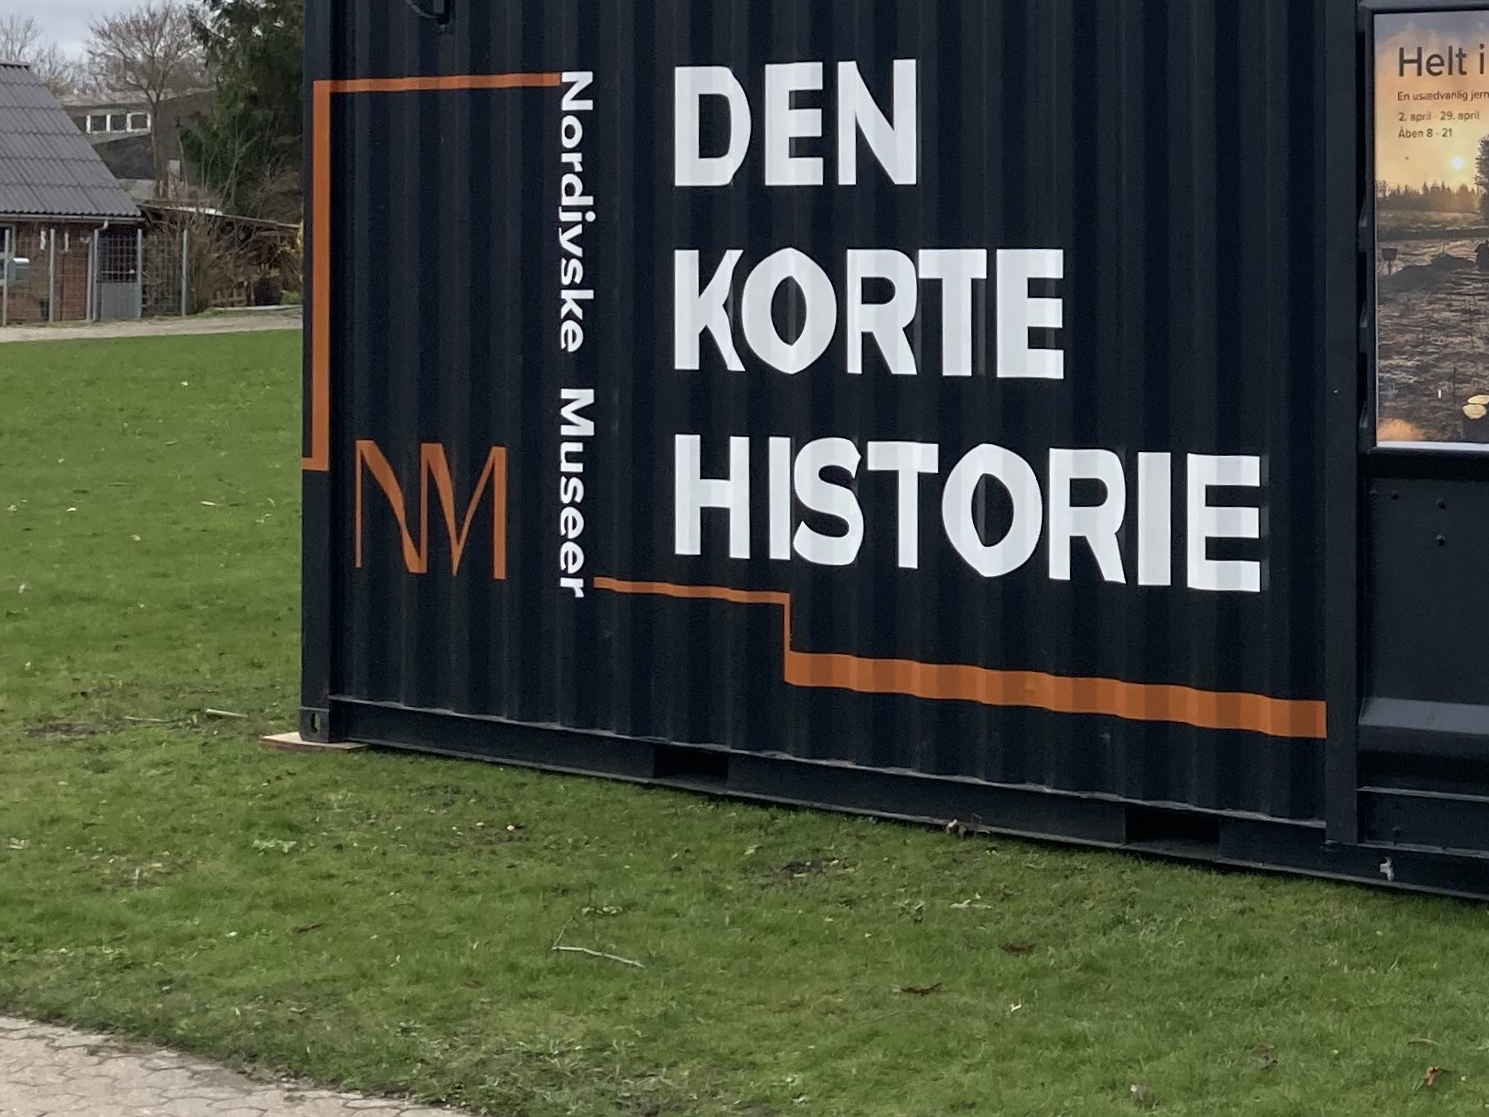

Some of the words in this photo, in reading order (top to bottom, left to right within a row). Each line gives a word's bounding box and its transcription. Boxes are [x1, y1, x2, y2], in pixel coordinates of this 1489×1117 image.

[674, 58, 917, 187] DEN
[1397, 91, 1410, 101] En
[1398, 45, 1467, 77] Helt
[1479, 43, 1485, 74] i
[1410, 111, 1431, 123] april
[1440, 111, 1455, 121] 29.
[1457, 110, 1480, 121] april
[1398, 126, 1424, 138] Åben
[1426, 128, 1433, 137] 8
[1442, 127, 1453, 137] 21
[556, 70, 595, 353] Nordjyske
[674, 247, 1064, 379] KORTE
[354, 439, 507, 581] NM
[559, 387, 595, 598] Museer
[674, 434, 1261, 592] HISTORIE
